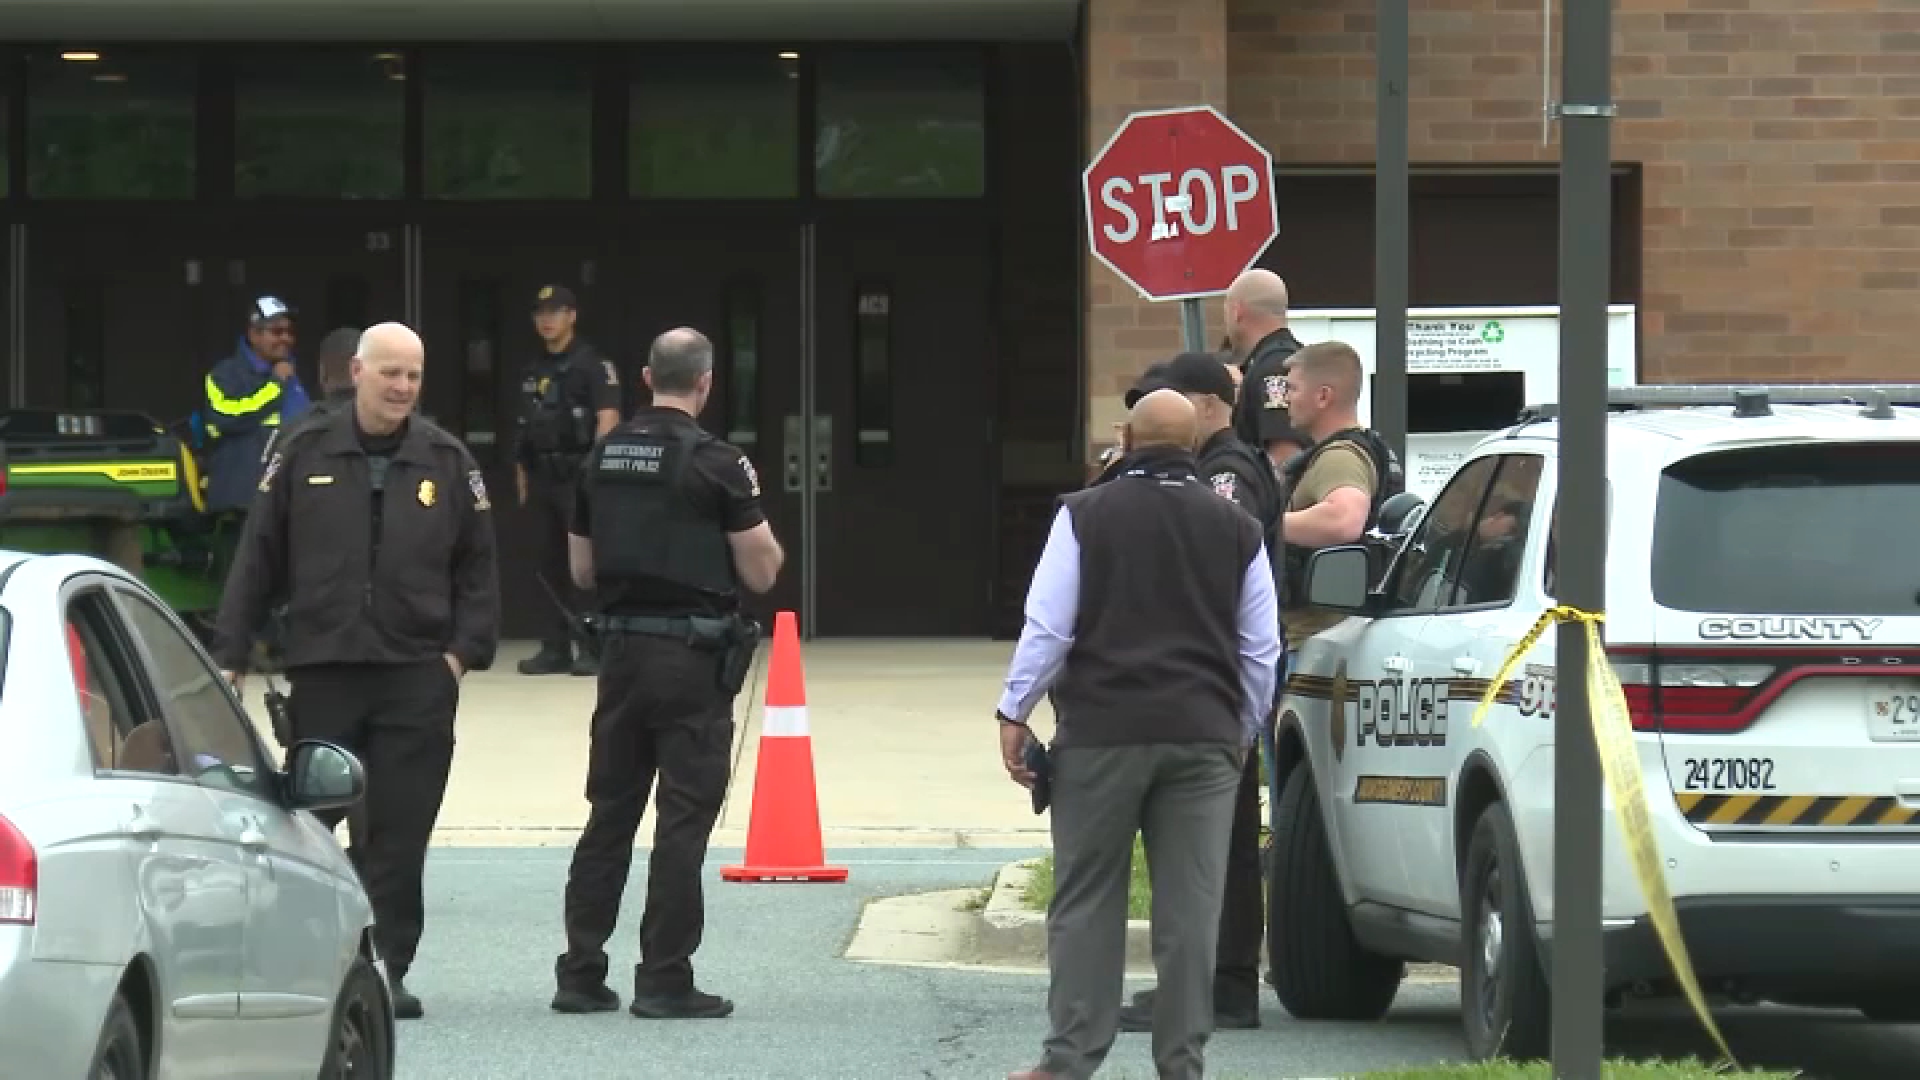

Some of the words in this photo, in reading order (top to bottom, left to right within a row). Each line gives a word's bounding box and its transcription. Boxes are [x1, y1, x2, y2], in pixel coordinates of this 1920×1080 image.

[1100, 165, 1260, 243] STOP
[1407, 338, 1444, 348] lothing
[1698, 617, 1884, 641] COUNTY
[1357, 677, 1449, 747] POLICE
[1684, 757, 1777, 790] 2421082
